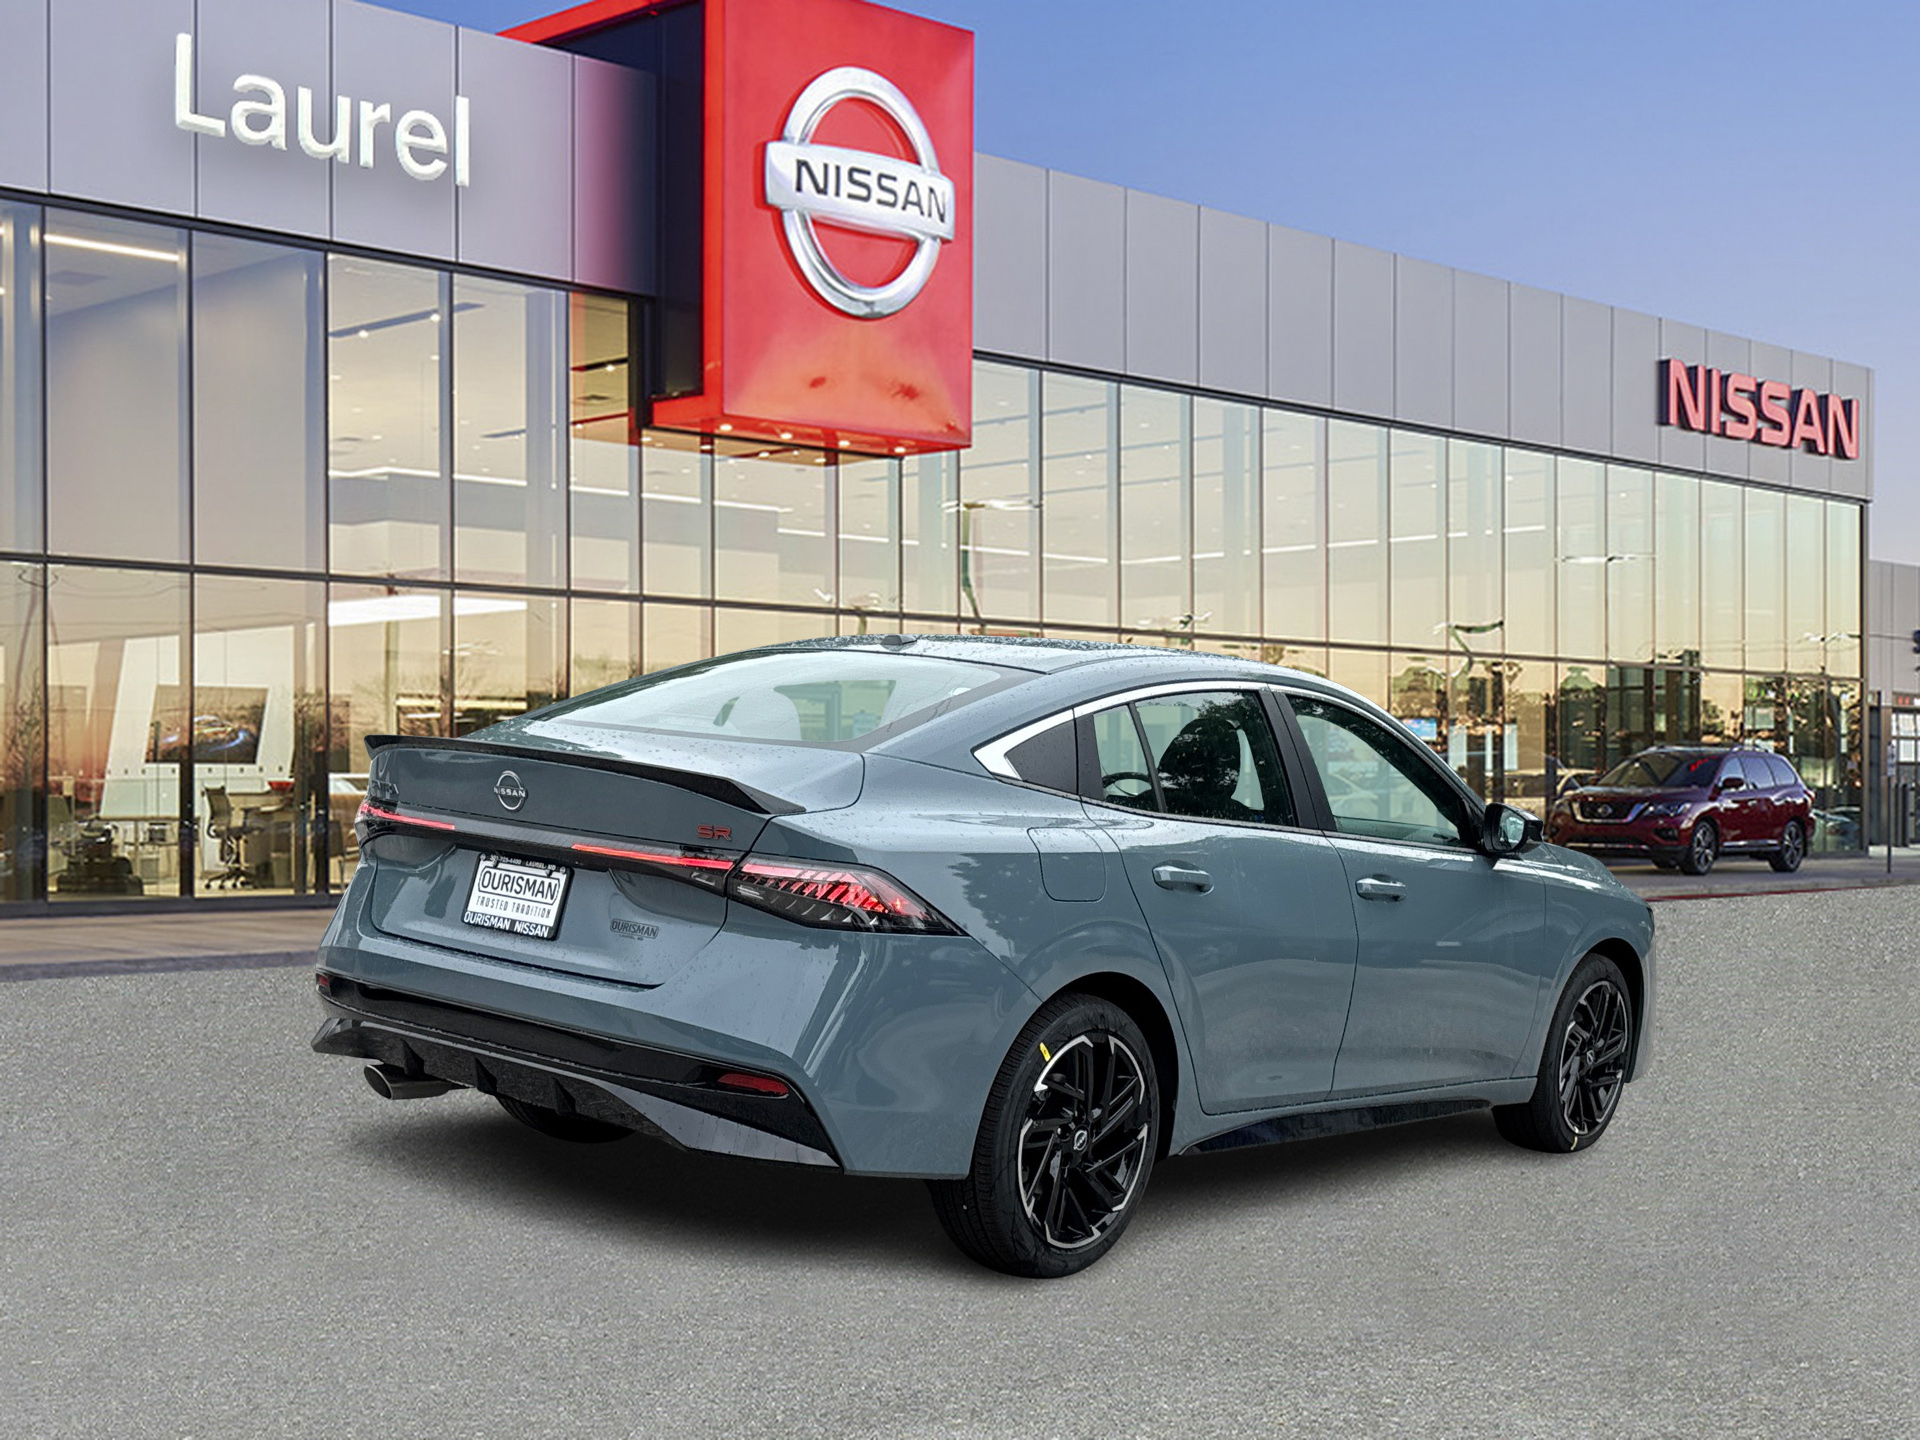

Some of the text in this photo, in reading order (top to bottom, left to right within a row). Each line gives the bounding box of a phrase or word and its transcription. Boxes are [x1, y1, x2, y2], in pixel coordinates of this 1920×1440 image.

[175, 33, 470, 187] Laurel
[795, 158, 947, 223] NISSAN
[1660, 357, 1860, 461] NISSAN
[493, 786, 526, 798] NISSAN
[697, 824, 732, 841] SR
[481, 870, 557, 901] OURISMAN
[476, 895, 551, 918] TRUSTED TRADITION
[463, 911, 549, 938] OURISMAN NISSAN
[611, 920, 658, 937] OURISMAN
